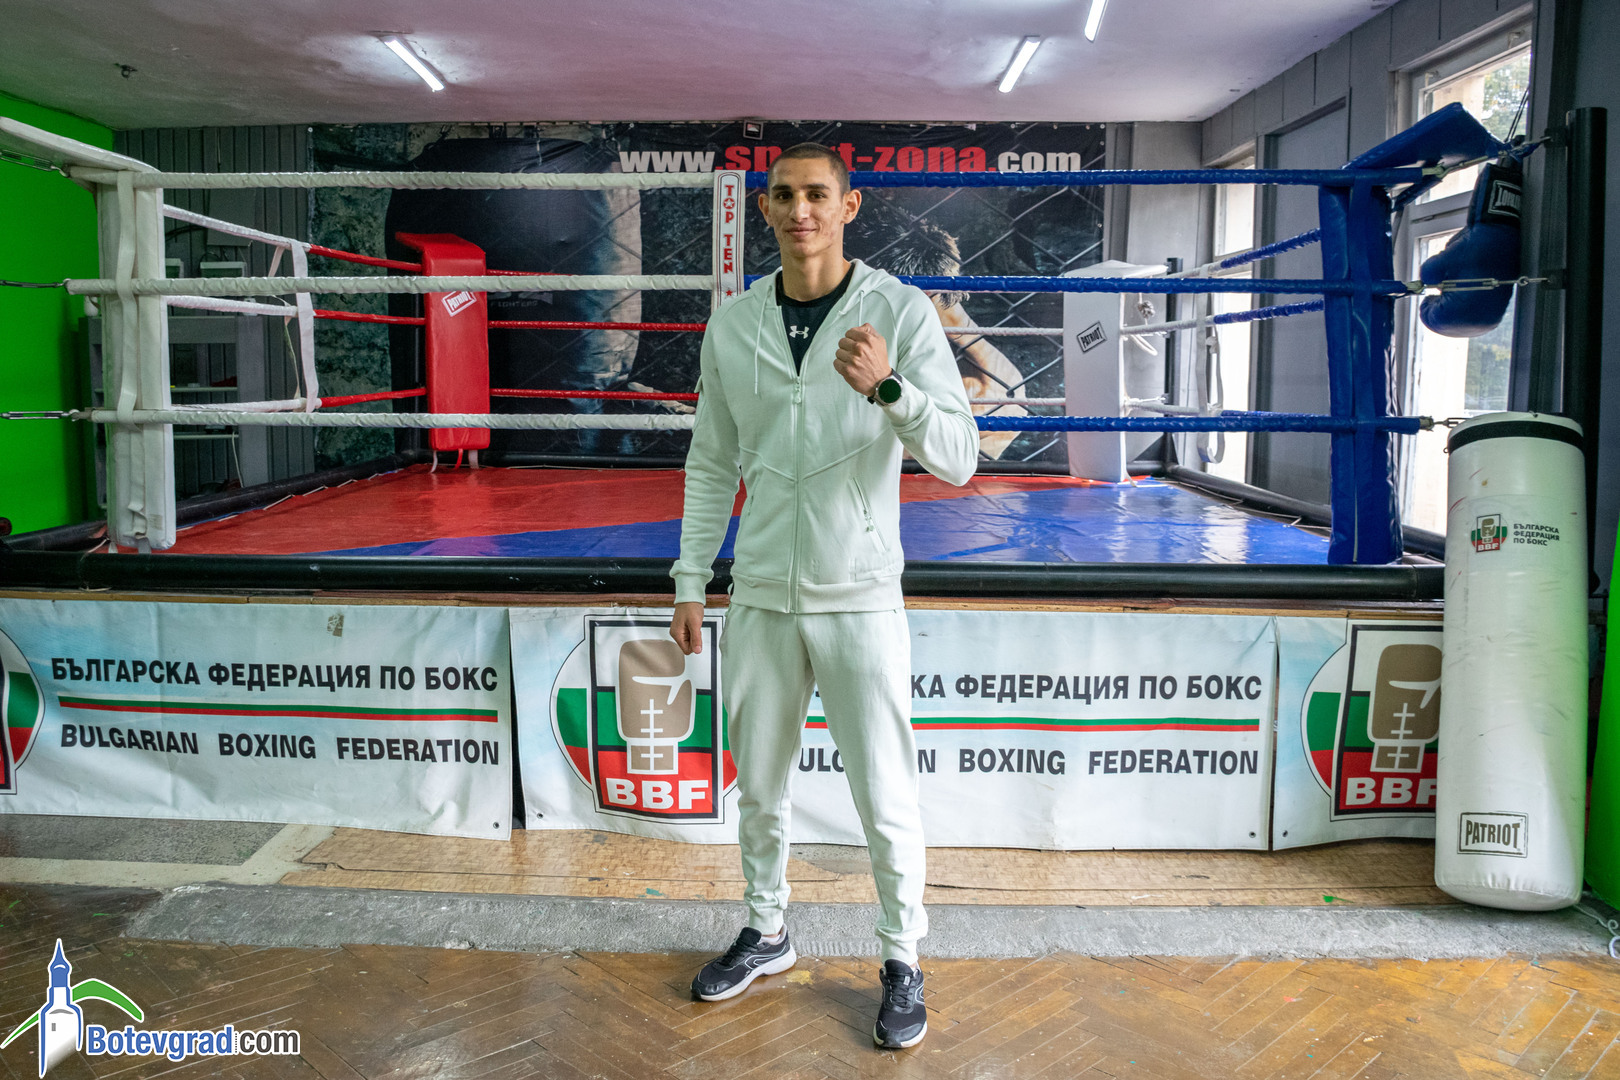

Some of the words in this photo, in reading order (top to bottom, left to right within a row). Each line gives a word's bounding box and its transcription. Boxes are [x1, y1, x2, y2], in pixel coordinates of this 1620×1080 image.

[619, 142, 1082, 173] www.spt-zona.com
[723, 184, 735, 224] TOP
[723, 234, 734, 274] TEN
[1080, 326, 1103, 349] PATRIOT
[1513, 523, 1560, 533] БЪЛГАРСКА
[1513, 531, 1560, 541] ФЕДЕРАЦИЯ
[1526, 538, 1548, 546] БОКС
[1477, 543, 1499, 551] BBF
[51, 657, 201, 685] БЪЛГАРСКА
[208, 662, 372, 692] ФЕДЕРАЦИЯ
[380, 665, 416, 691] ПО
[425, 666, 499, 692] БОКС
[955, 674, 1129, 705] ФЕДЕРАЦИЯ
[1139, 675, 1178, 700] ПО
[1186, 675, 1262, 700] БОКС
[61, 723, 199, 755] BULGARIAN
[219, 733, 317, 759] BOXING
[337, 737, 499, 765] FEDERATION
[959, 748, 1066, 775] BOXING
[1088, 749, 1258, 775] FEDERATION
[605, 778, 709, 810] BBF
[1465, 820, 1521, 849] PATRIOT
